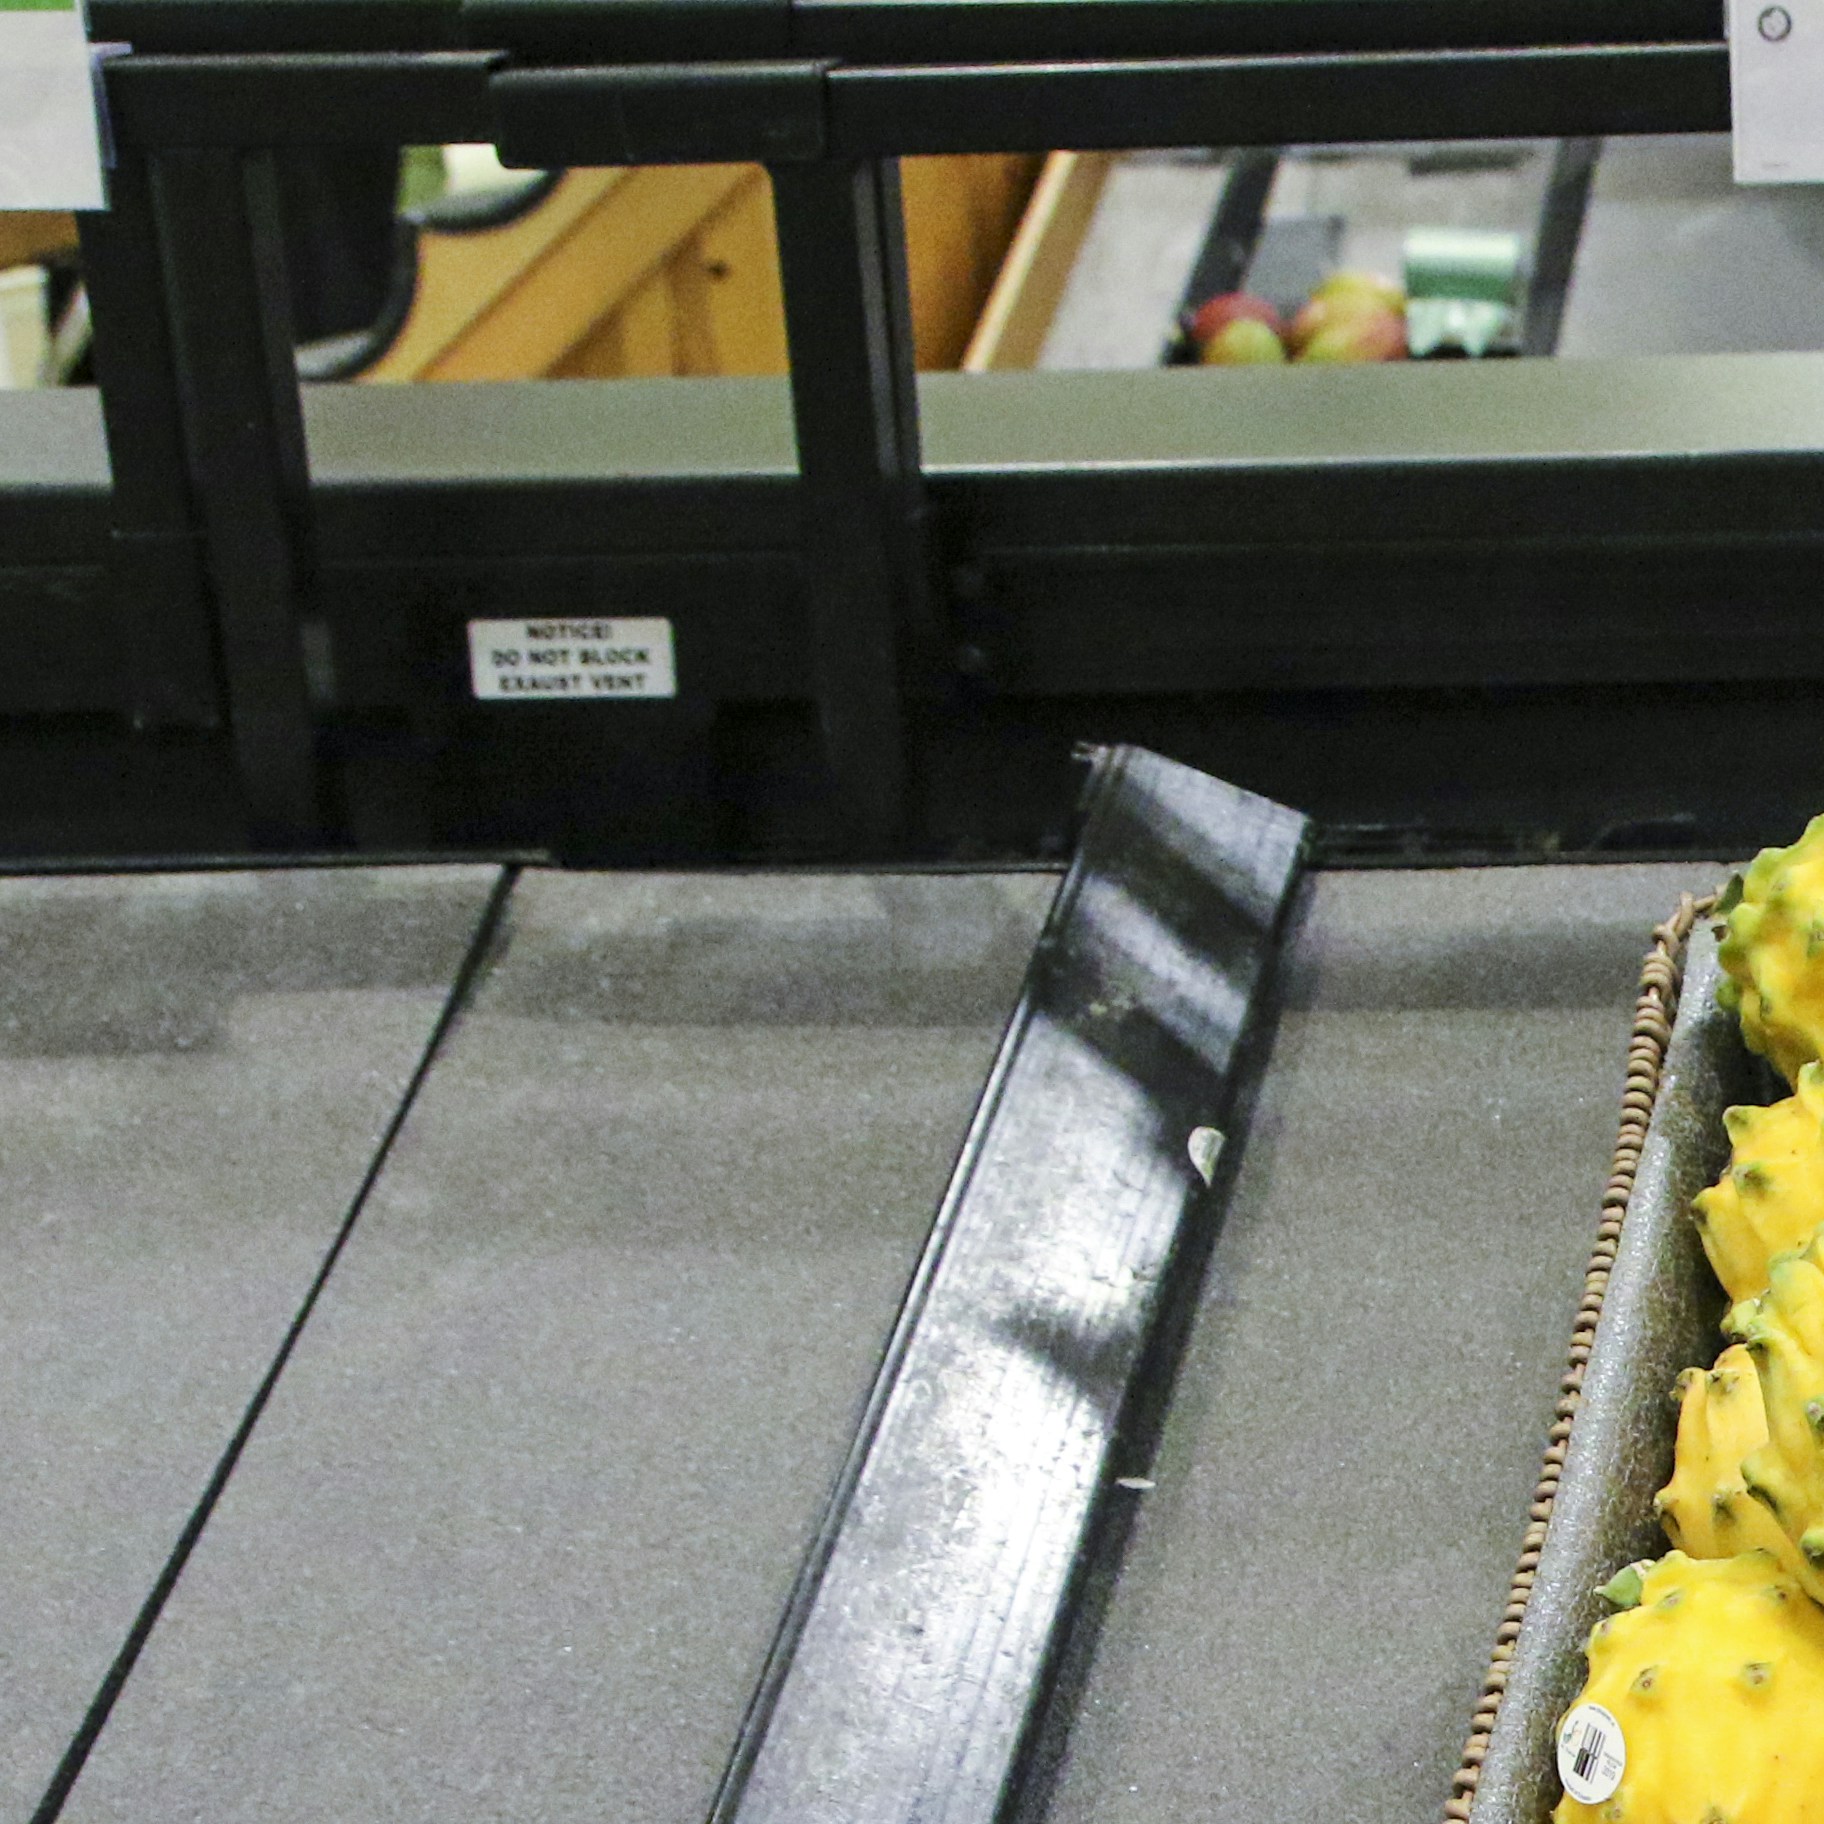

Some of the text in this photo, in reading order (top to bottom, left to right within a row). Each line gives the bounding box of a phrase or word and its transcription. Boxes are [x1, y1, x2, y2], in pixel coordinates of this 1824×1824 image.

[491, 647, 651, 667] DO NOT BLOCK
[590, 672, 645, 690] VENT
